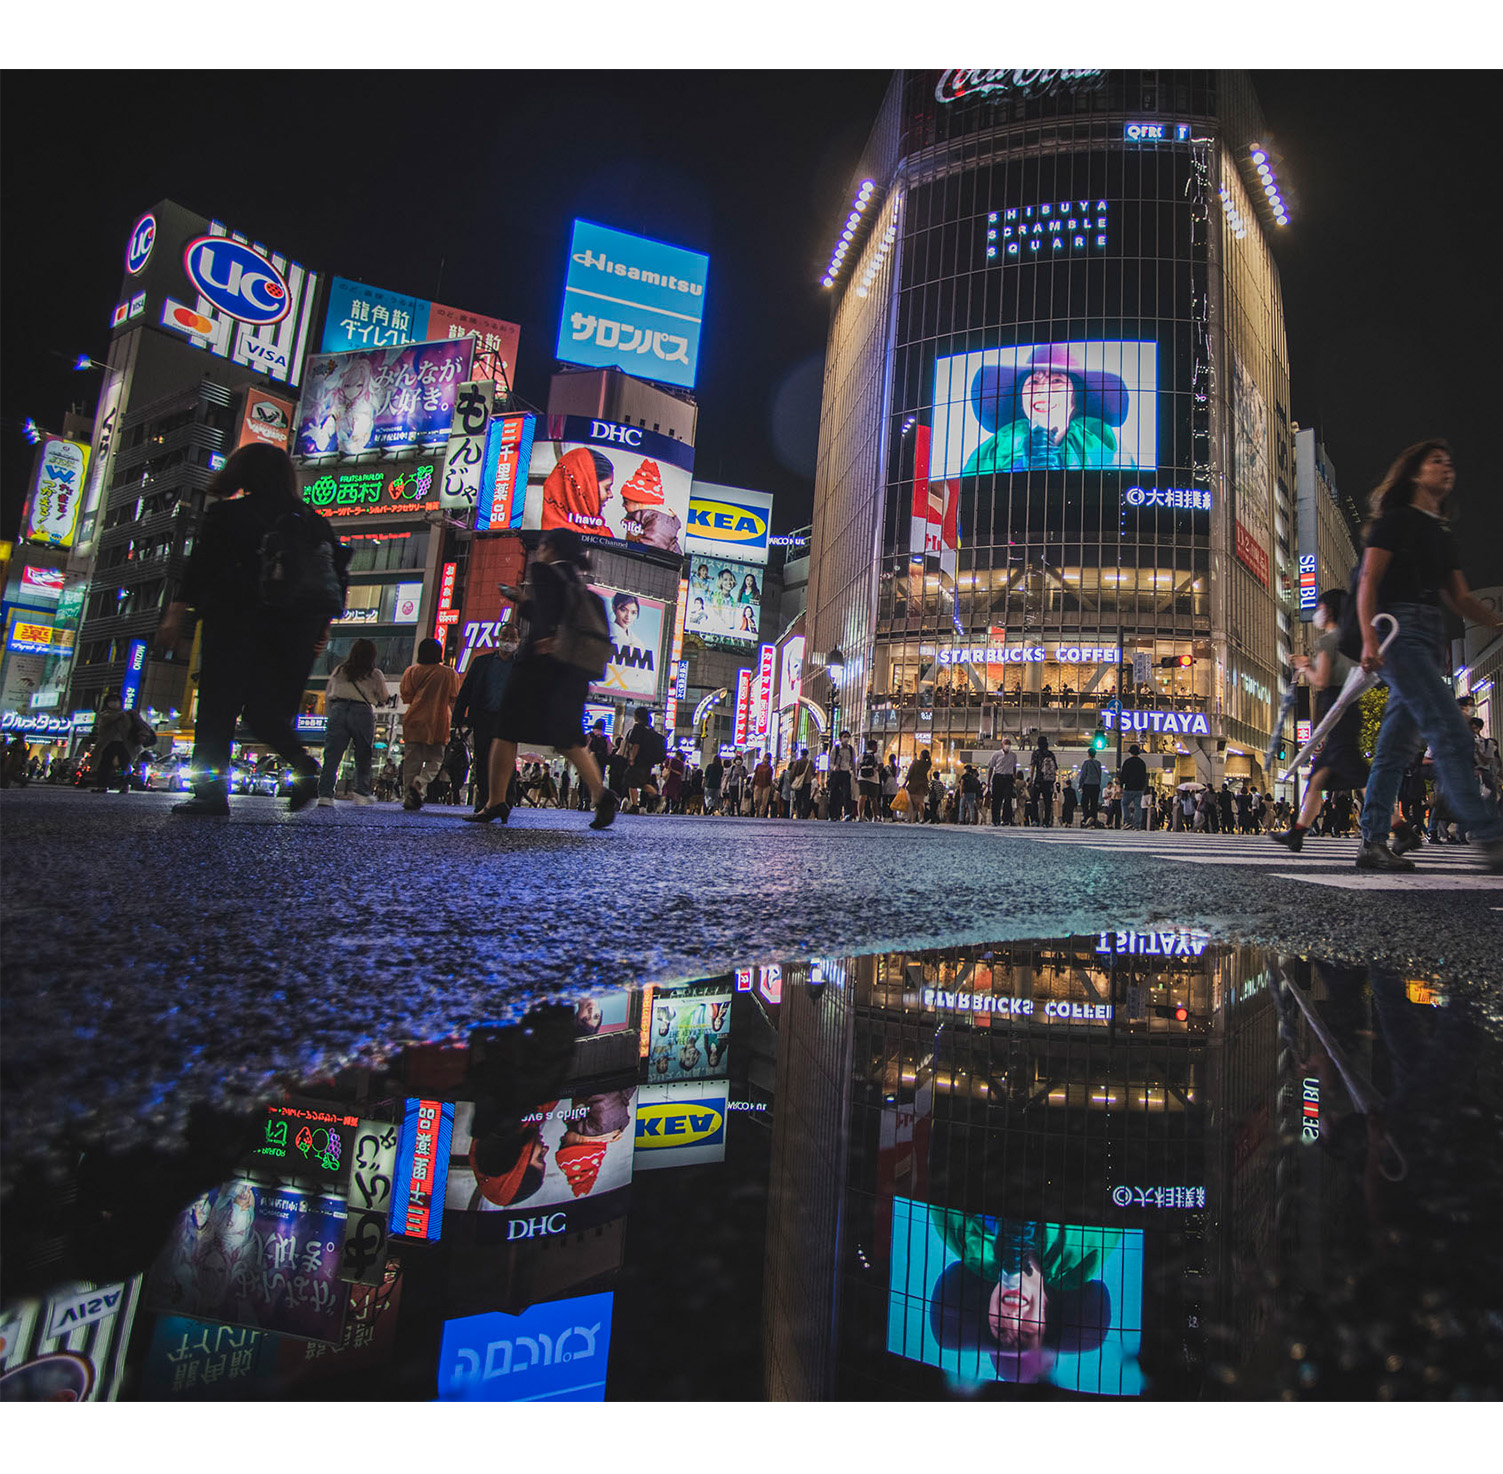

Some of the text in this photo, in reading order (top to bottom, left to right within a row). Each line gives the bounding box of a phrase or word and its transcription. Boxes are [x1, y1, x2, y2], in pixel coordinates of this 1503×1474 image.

[988, 200, 1107, 222] SHIBUYA
[988, 218, 1106, 240] SCRAMBLE
[131, 228, 153, 261] UC
[987, 235, 1106, 257] SQUARE
[199, 246, 280, 312] UC
[572, 250, 703, 296] Hisamitsu
[351, 299, 411, 331] 龍角散
[571, 312, 689, 365] サロンパス
[247, 340, 287, 368] VISA
[374, 356, 464, 388] みんなが
[375, 388, 450, 416] 大好き。
[444, 383, 490, 505] もんじゃ
[591, 421, 643, 446] DHC
[489, 421, 518, 523] 三千里薬品
[336, 481, 383, 505] 西村
[574, 512, 604, 527] have
[684, 508, 759, 535] KEA
[1299, 554, 1317, 610] SEIBU
[344, 609, 379, 622] クリニック
[20, 624, 51, 643] 薬
[132, 644, 146, 671] MIZUHO
[610, 642, 655, 672] MM
[939, 648, 1046, 664] STARBUCKS
[604, 664, 629, 690] X
[1, 710, 73, 732] グルメタウン
[1101, 710, 1209, 734] TSUTAYA
